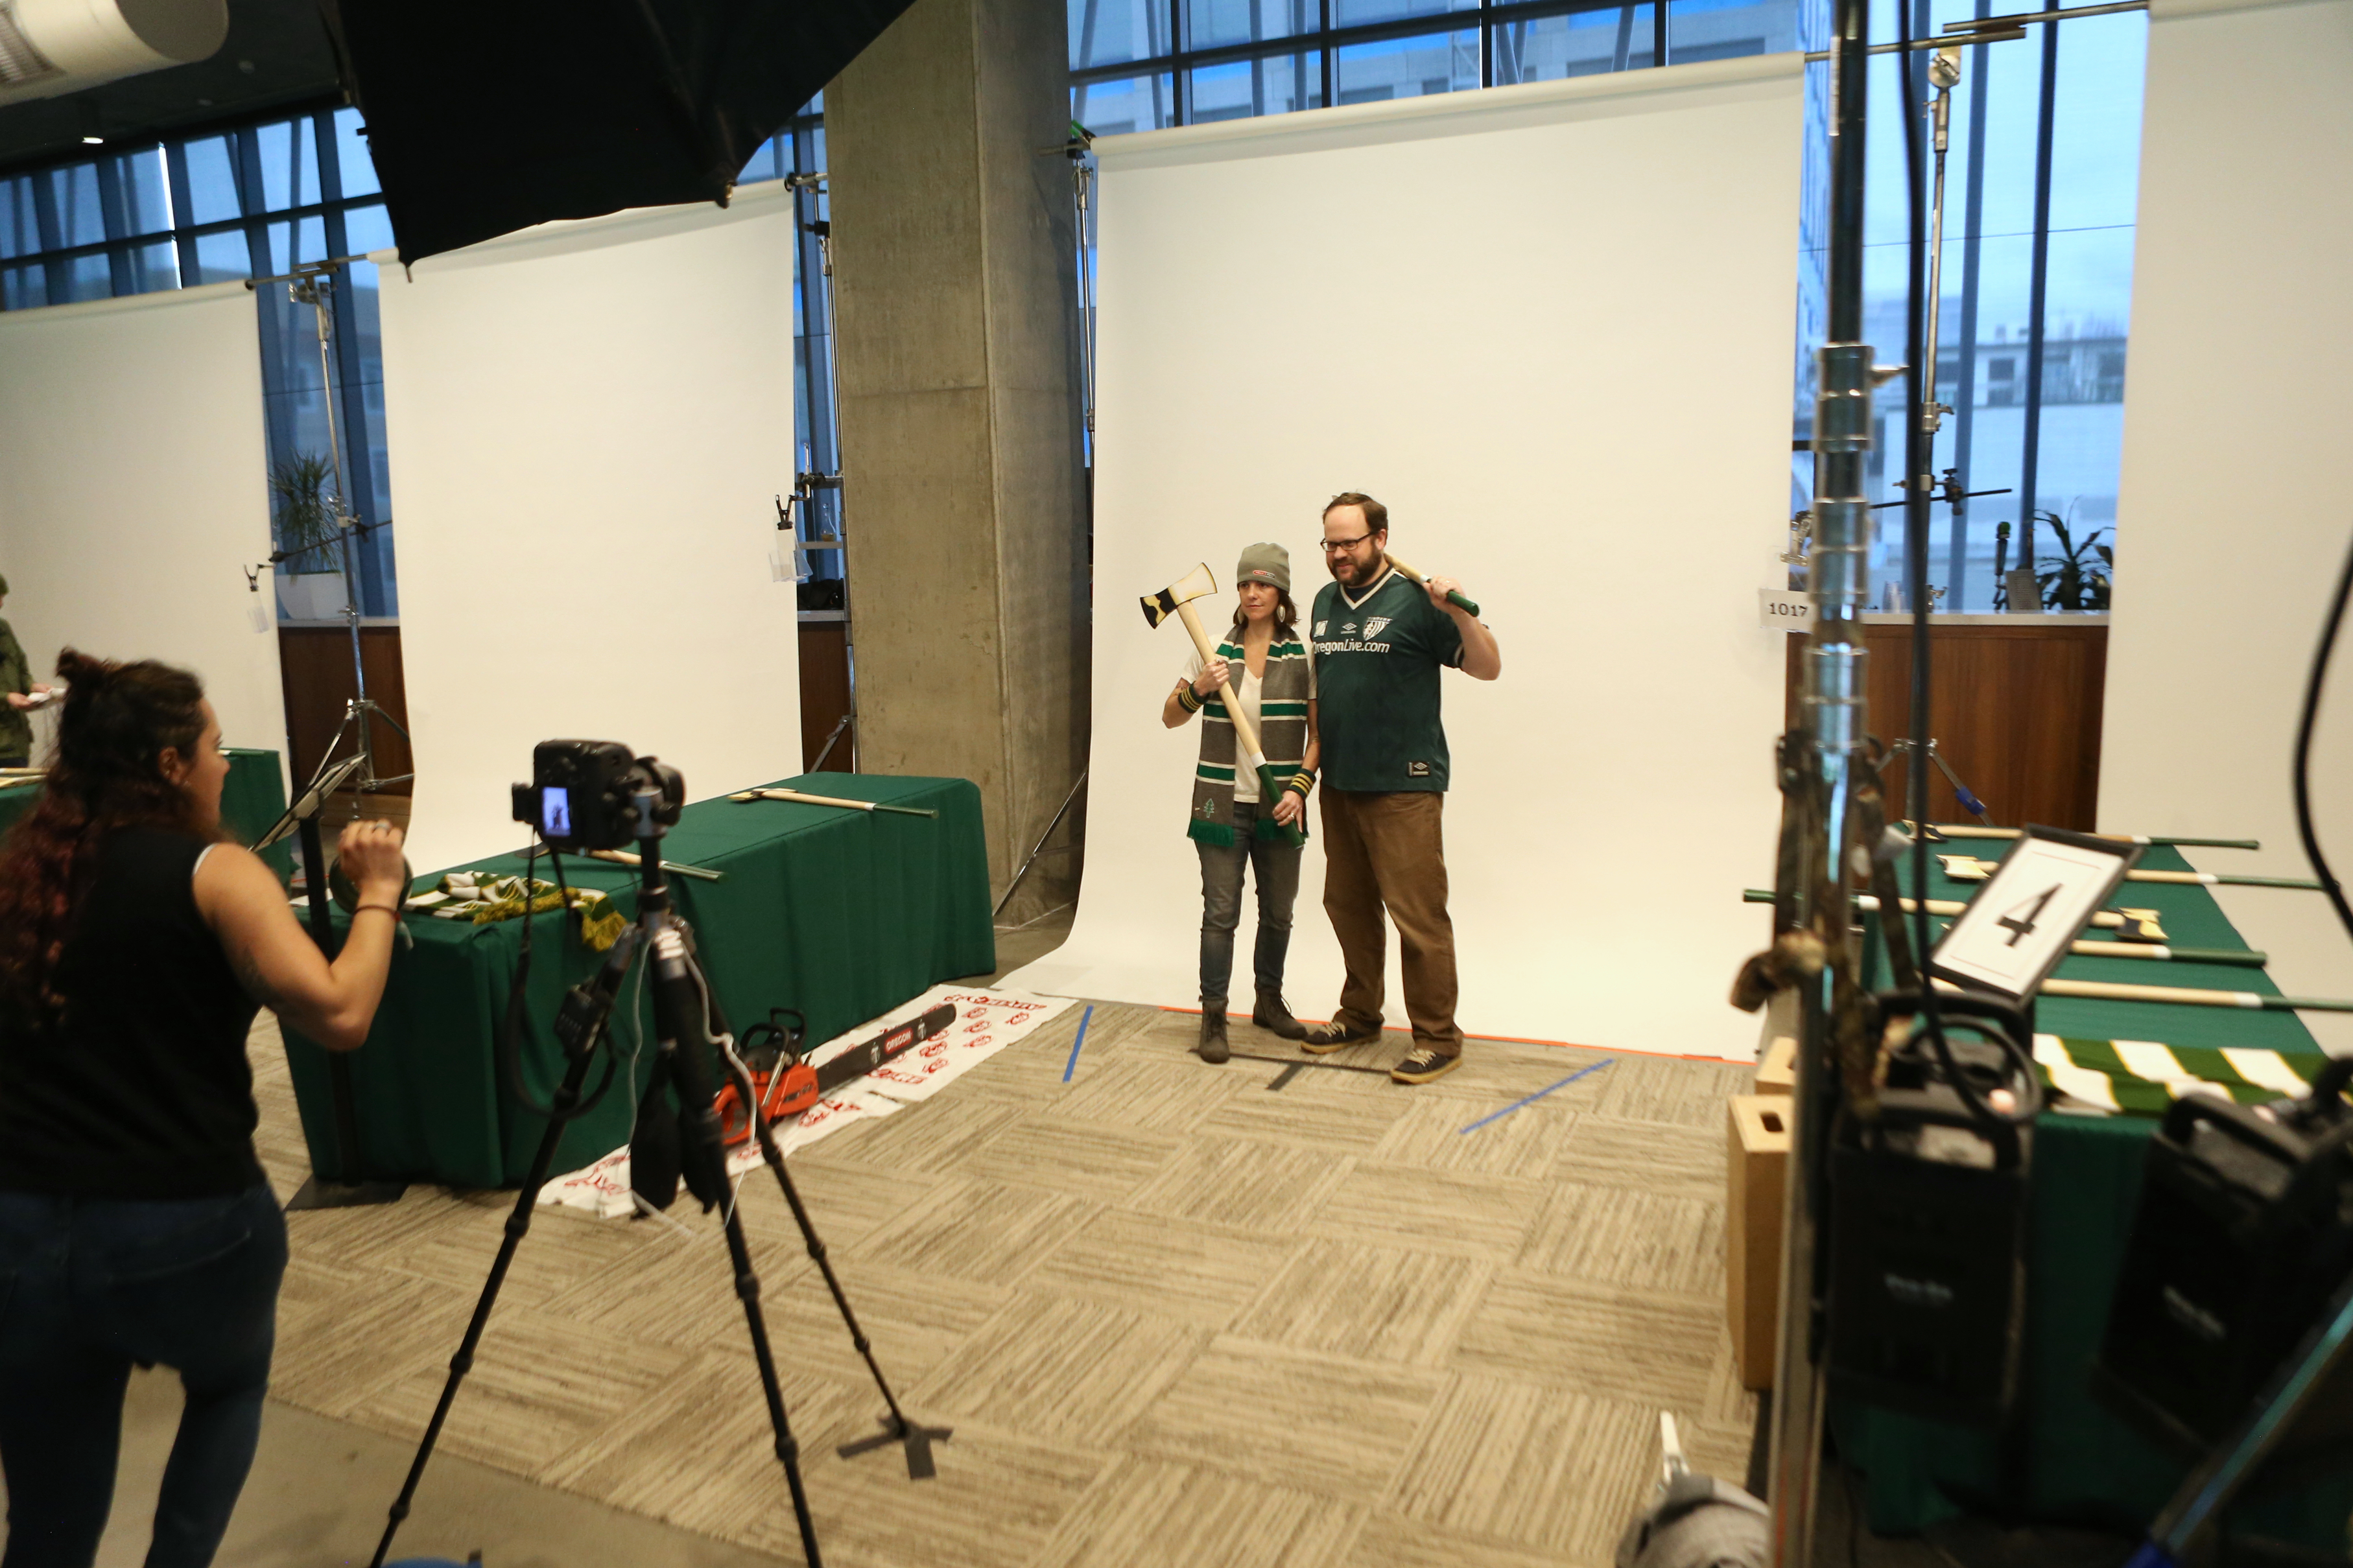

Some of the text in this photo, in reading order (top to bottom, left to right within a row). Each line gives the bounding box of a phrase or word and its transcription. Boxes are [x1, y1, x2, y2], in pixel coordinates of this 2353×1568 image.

[1769, 602, 1808, 617] 1017
[1996, 882, 2064, 948] 4
[886, 1031, 911, 1052] OREGON
